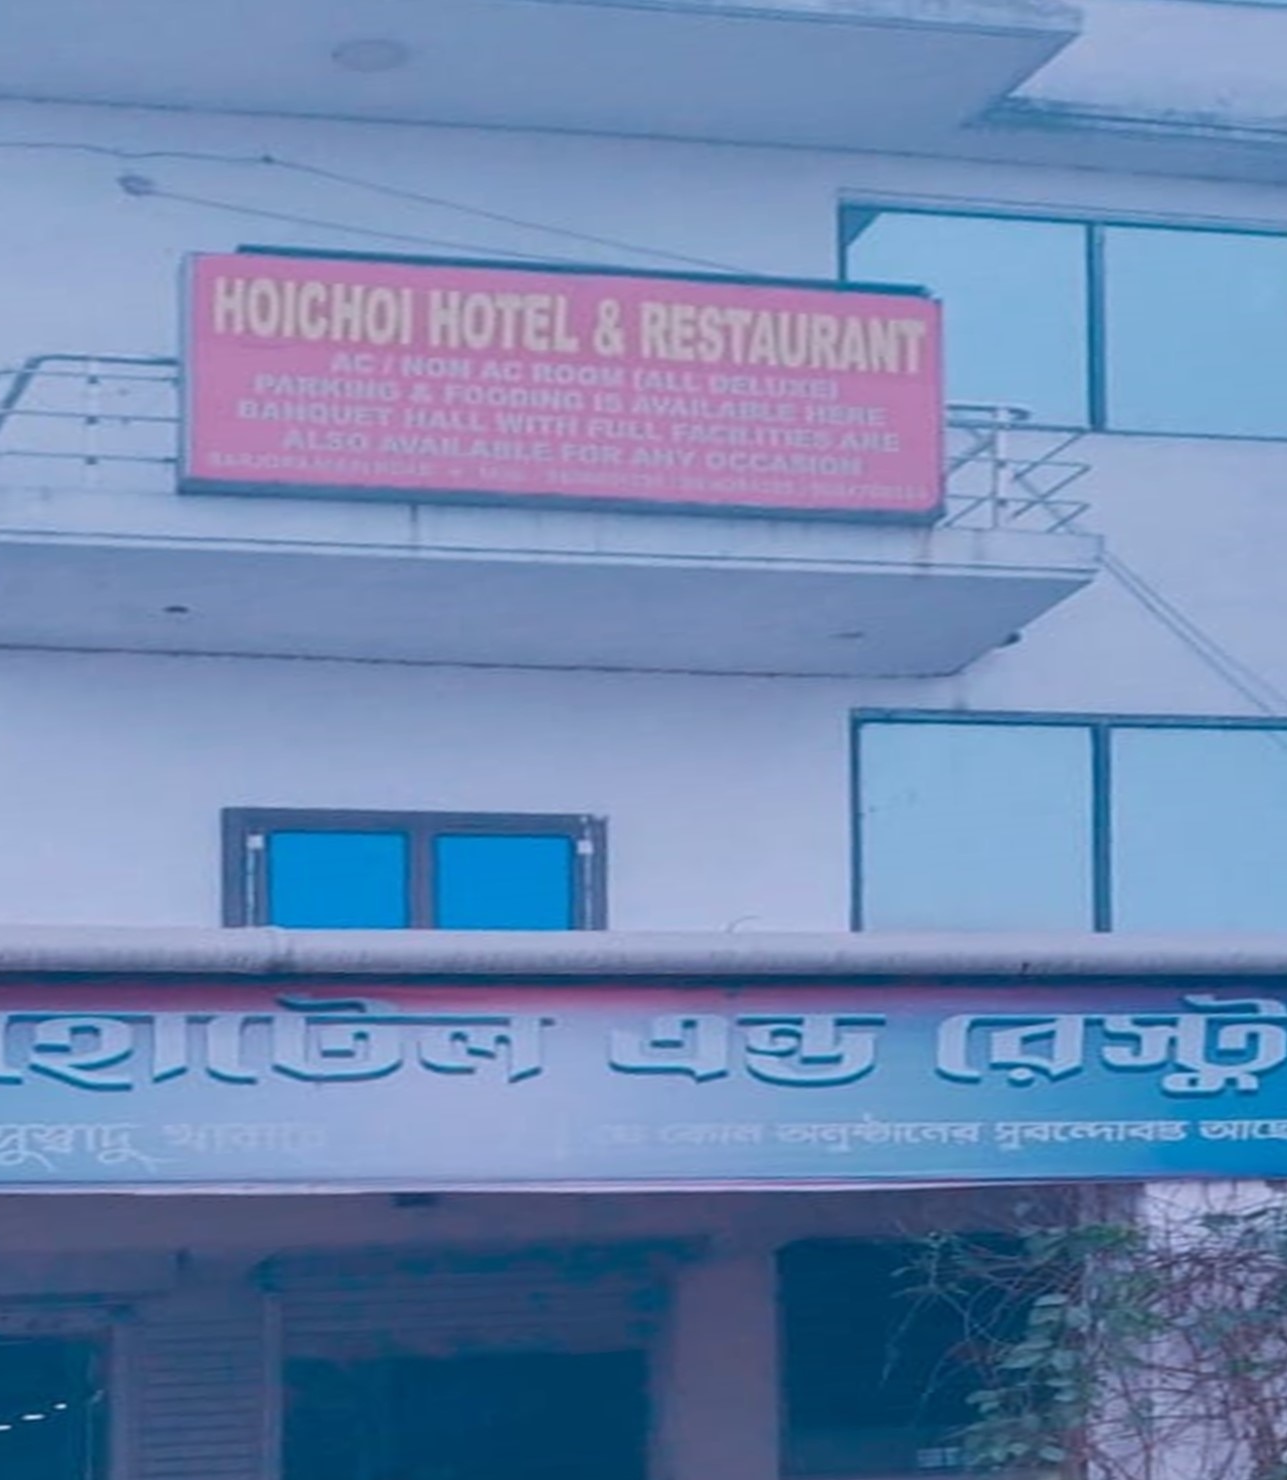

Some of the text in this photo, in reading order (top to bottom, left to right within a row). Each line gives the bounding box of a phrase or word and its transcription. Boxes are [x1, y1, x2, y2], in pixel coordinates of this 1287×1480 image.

[214, 276, 926, 374] HOICHOI HOTEL & RESTAURANT
[329, 353, 375, 373] AC
[400, 356, 471, 379] NON
[480, 362, 524, 382] AC
[531, 363, 624, 387] ROOM
[236, 398, 901, 453] BANQUET HALL WITH FULL FACILITIES ARE
[252, 373, 888, 427] PARKING & FOODING IS AVAILABLE HERE
[282, 428, 864, 477] ALSO AVAILABLE FOR ANY OCCASION
[609, 1013, 887, 1088] এন্ড
